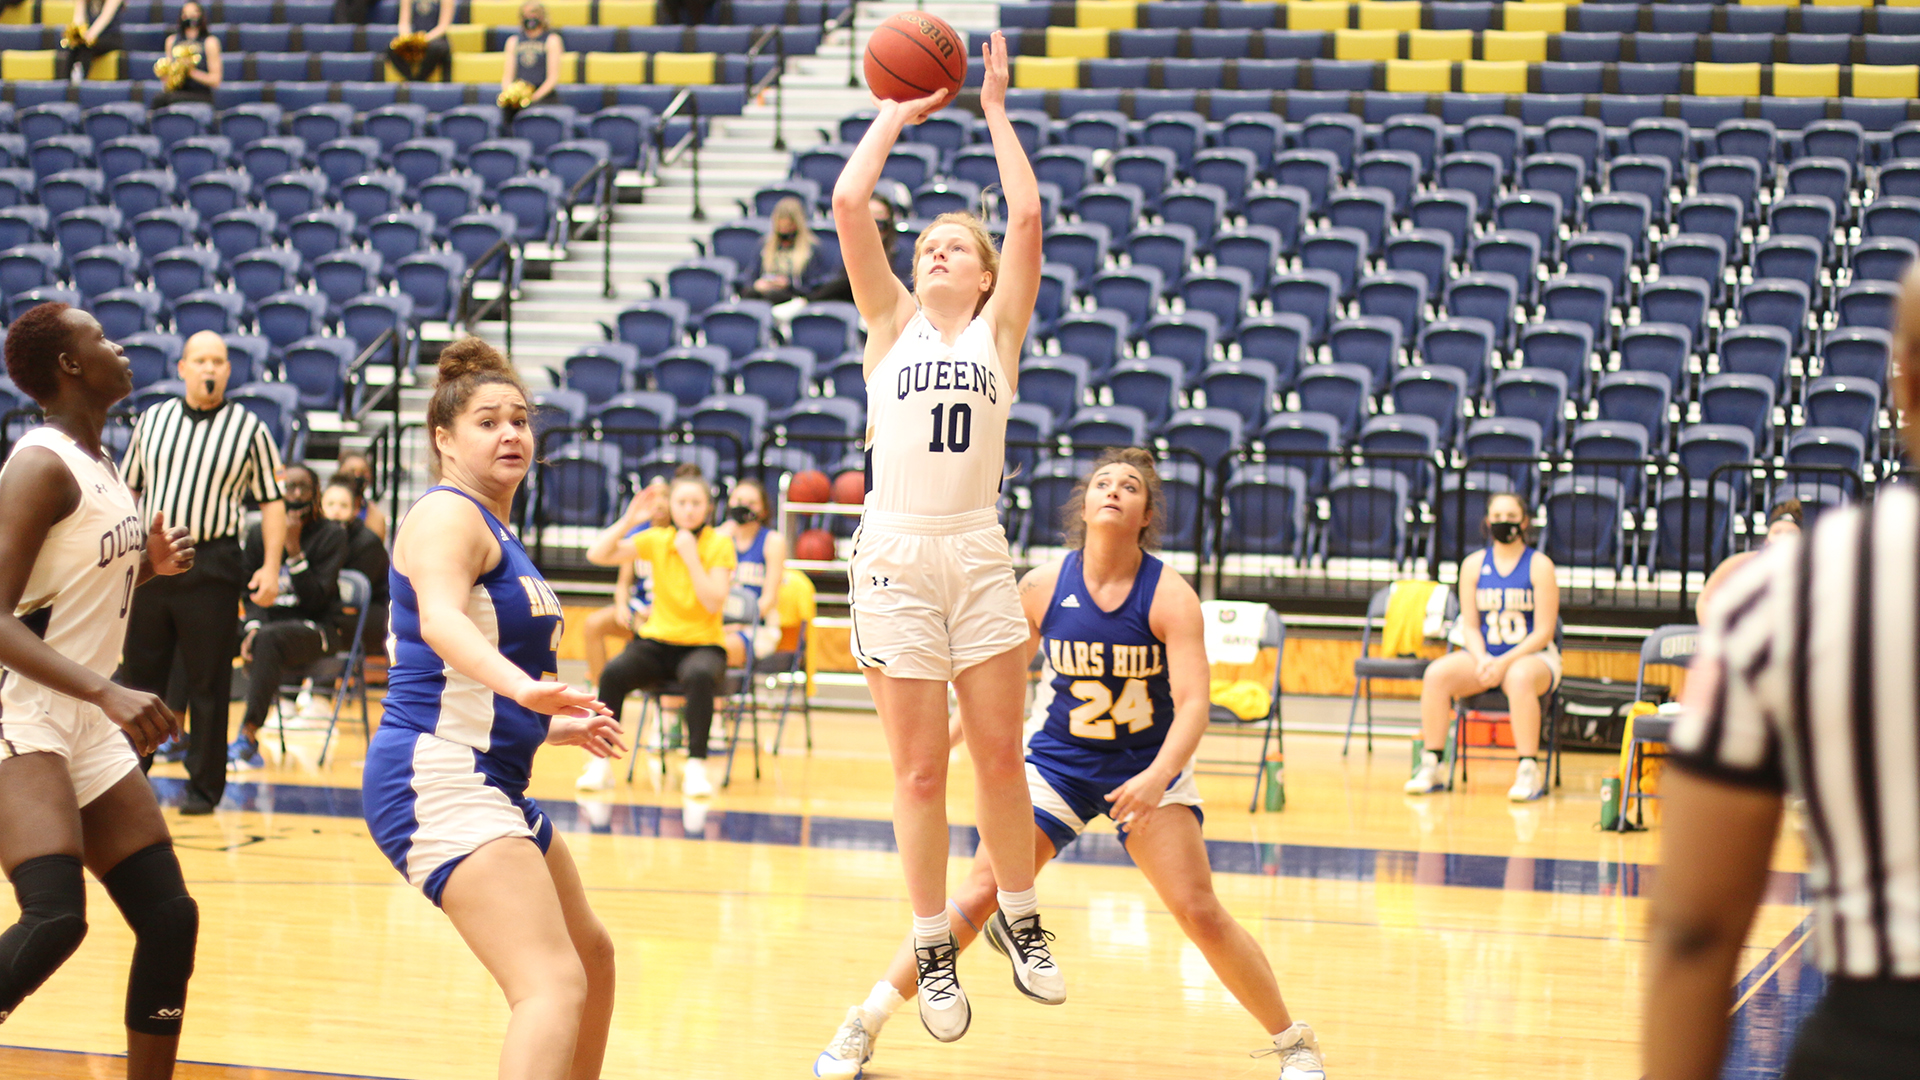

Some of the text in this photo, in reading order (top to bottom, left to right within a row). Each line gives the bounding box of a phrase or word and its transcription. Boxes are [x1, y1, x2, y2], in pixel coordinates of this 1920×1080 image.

[897, 360, 997, 405] QUEENS
[928, 402, 972, 453] 10
[1485, 609, 1528, 645] 10
[1049, 638, 1163, 679] MARS HILL
[1068, 677, 1155, 740] 24
